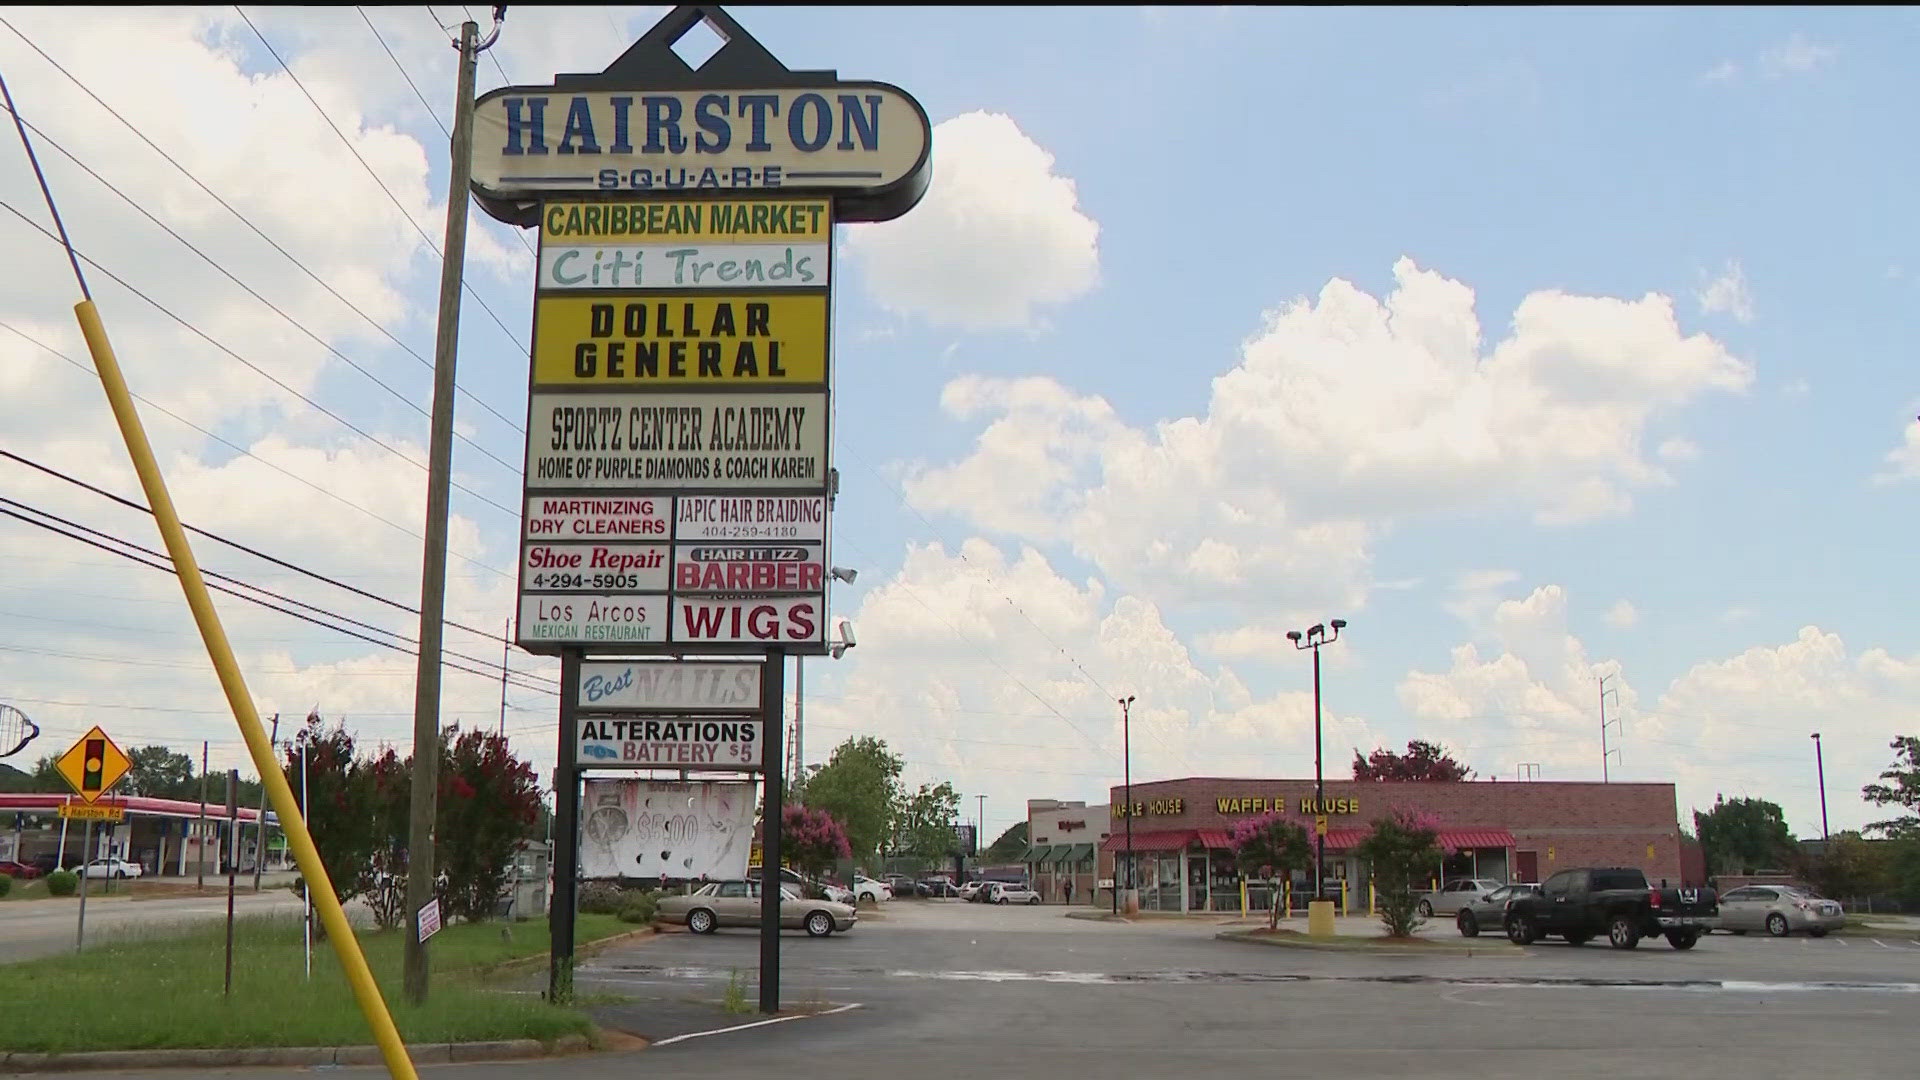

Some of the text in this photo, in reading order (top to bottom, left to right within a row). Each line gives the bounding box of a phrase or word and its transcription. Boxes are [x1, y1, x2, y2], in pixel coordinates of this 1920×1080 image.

[502, 93, 883, 156] HAIRSTON
[547, 204, 824, 236] CARIBBEAN MARKET
[552, 247, 814, 286] Citi Trends
[591, 303, 770, 338] DOLLAR
[574, 341, 786, 378] GENERAL
[551, 407, 805, 451] SPORTZ CENTER ACADEMY
[538, 457, 815, 479] HOME OF PURPLE DIAMONDS & COACH KAREM
[543, 501, 654, 515] MARTINIZING
[679, 499, 821, 523] JAPIC HAIR BRAIDING
[530, 519, 666, 534] DRY CLEANERS
[702, 526, 797, 538] 404-259-4180
[528, 547, 664, 573] Shoe Repair
[700, 549, 799, 560] HAIR IT IZZ
[533, 573, 638, 588] 4-294-5905
[676, 563, 822, 590] BARBER
[538, 600, 646, 623] Los Arcos
[683, 603, 815, 640] WIGS
[532, 625, 651, 640] MEXICAN RESTAURANT
[583, 668, 633, 702] Best
[581, 721, 755, 742] ALTERATIONS
[623, 741, 752, 763] BATTERY $5
[1150, 799, 1181, 815] HOUSE
[1217, 798, 1284, 813] WAFFLE
